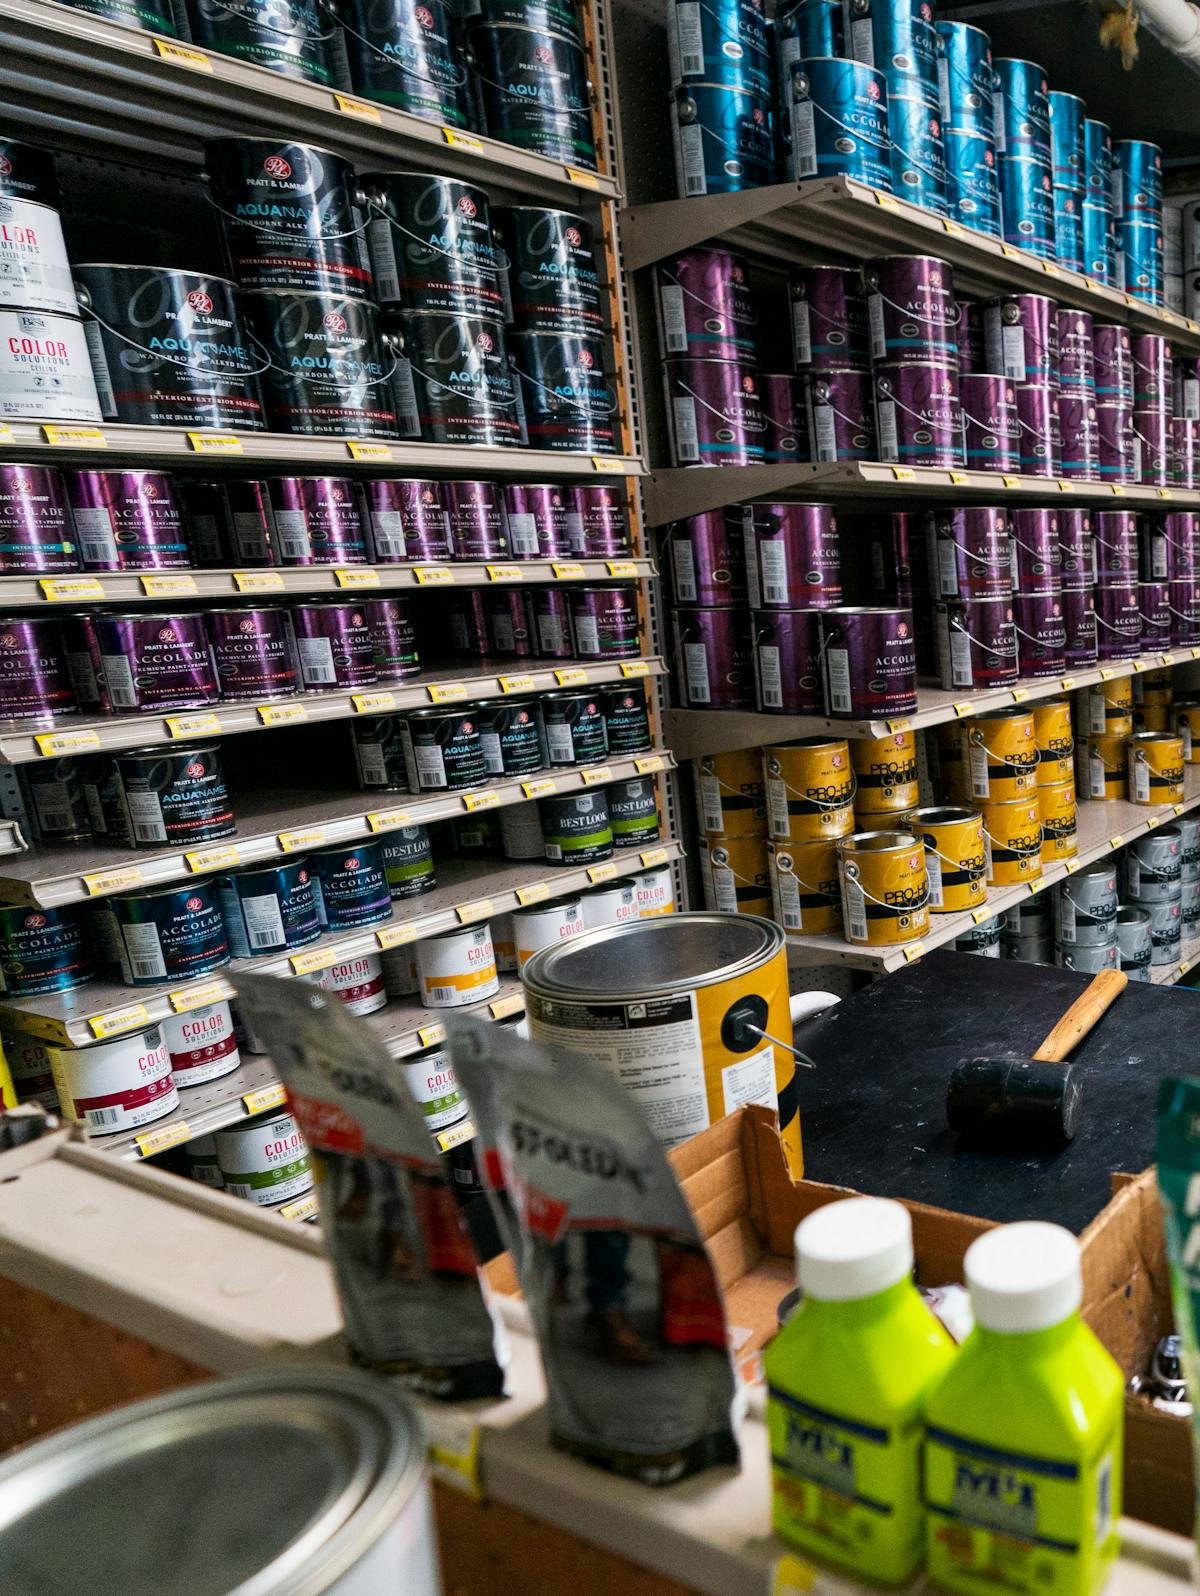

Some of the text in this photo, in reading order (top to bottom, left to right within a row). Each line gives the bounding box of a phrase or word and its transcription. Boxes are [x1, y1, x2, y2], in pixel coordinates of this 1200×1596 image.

[1, 224, 37, 246] LOR
[203, 316, 233, 328] LAMBERT
[9, 337, 67, 358] COLOR
[13, 353, 70, 367] SOLUTIONS
[30, 364, 58, 373] CEILING
[170, 641, 194, 650] LAMBERT
[216, 641, 284, 653] ACCOLADE
[135, 651, 207, 664] ACCOLADE
[612, 801, 634, 813] BEST
[560, 811, 607, 829] BEST LOOK
[384, 845, 412, 859] BEST
[324, 872, 383, 890] ACCOLADE
[173, 914, 189, 923] PRATT
[195, 906, 214, 918] LAMBERT
[161, 913, 222, 937] ACCOLADE
[332, 959, 369, 978] COLOR
[334, 971, 371, 984] SOLUTIONS
[182, 1014, 223, 1038] COLOR
[185, 1027, 225, 1044] SOLUTIONS
[427, 1069, 455, 1089] COLO
